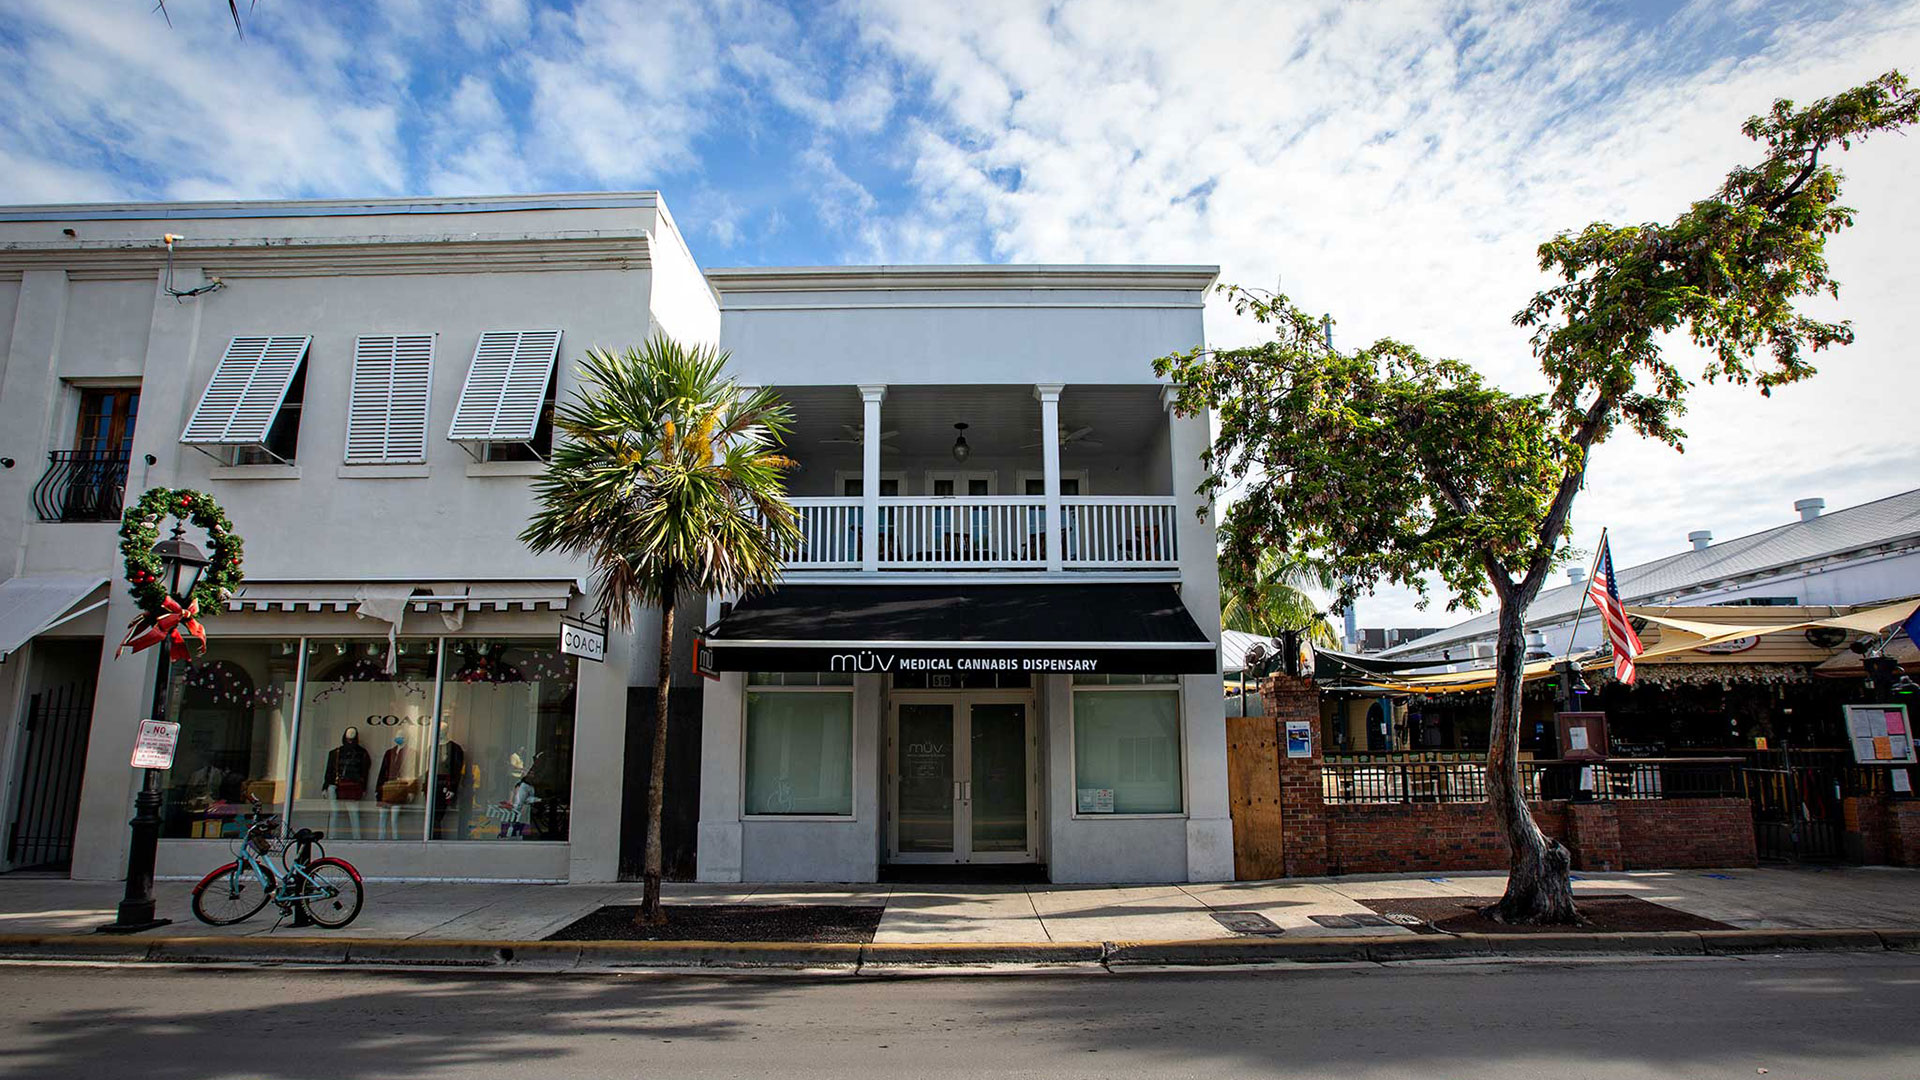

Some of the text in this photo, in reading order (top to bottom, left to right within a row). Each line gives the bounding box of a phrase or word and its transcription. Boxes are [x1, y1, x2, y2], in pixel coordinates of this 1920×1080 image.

[565, 632, 602, 654] COACH
[900, 658, 953, 670] MEDICAL
[957, 658, 1018, 670] CANNABIS
[1023, 659, 1097, 671] DISPENSARY
[366, 714, 433, 727] COAC
[153, 726, 166, 735] NO
